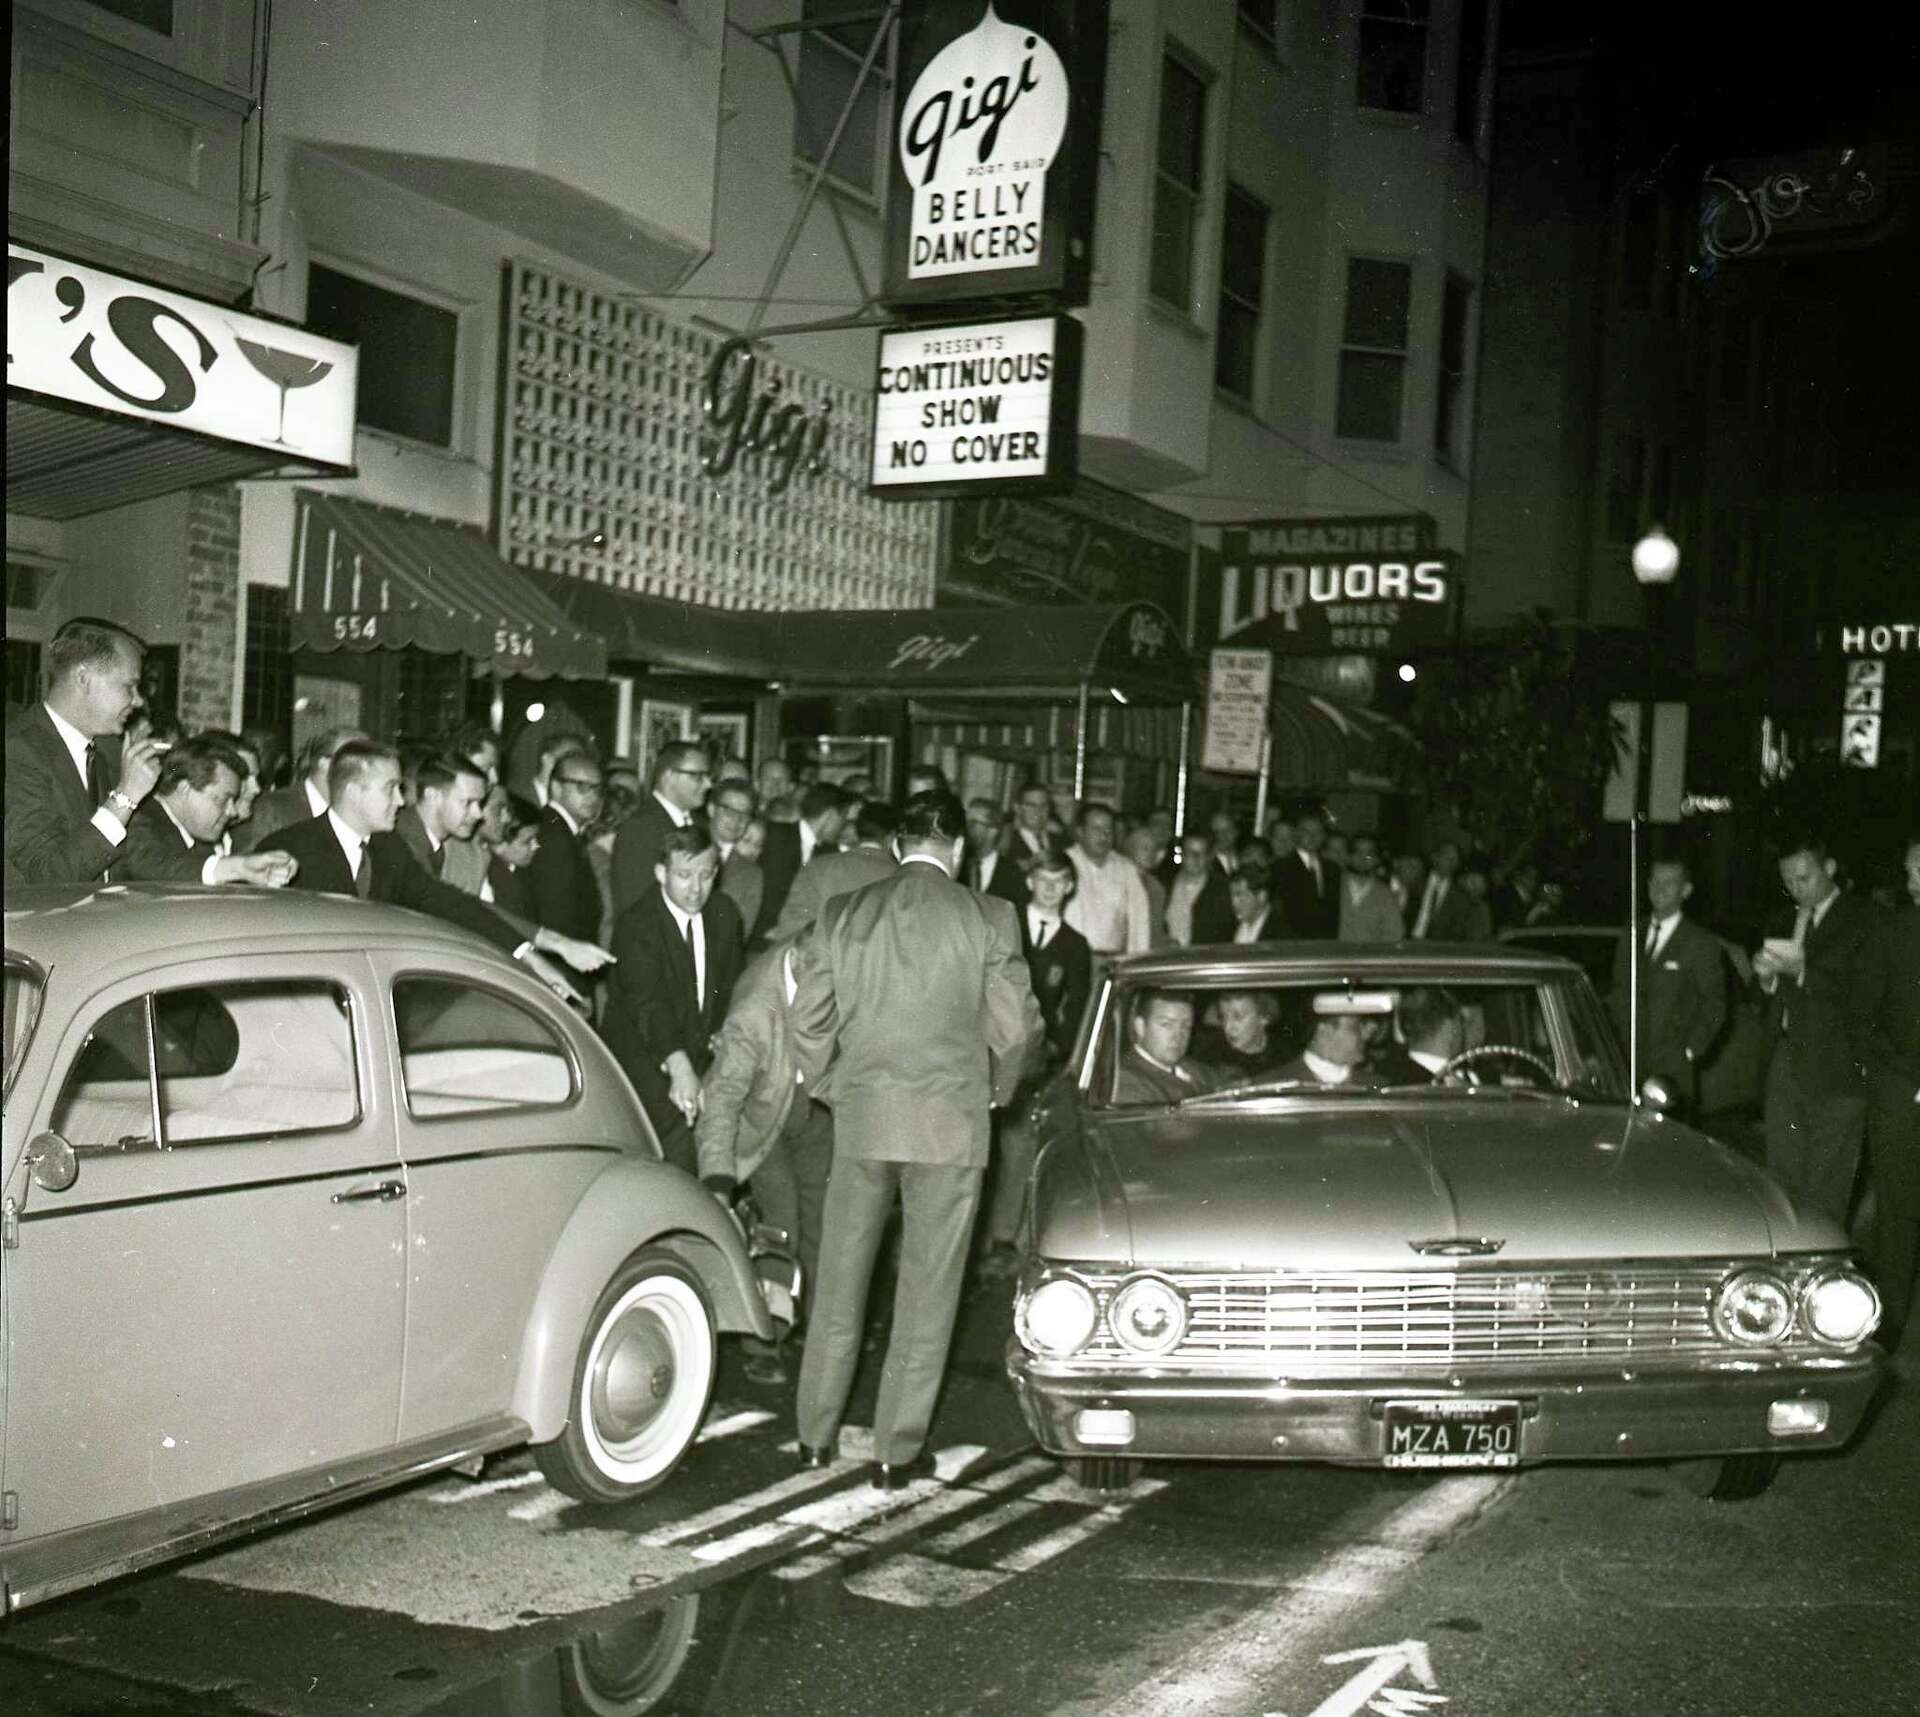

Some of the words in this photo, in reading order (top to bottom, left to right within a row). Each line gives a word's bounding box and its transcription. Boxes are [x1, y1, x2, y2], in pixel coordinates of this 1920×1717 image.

[966, 163, 1004, 176] PORT
[929, 181, 1031, 224] BELLY
[914, 222, 1038, 266] DANCERS
[7, 255, 218, 413] 'S
[923, 335, 1004, 354] PRESENTS
[879, 352, 1050, 394] CONTINUOUS
[921, 395, 1002, 428] SHOW
[891, 440, 927, 468] NO
[952, 431, 1039, 464] COVER
[1249, 525, 1417, 552] MAGAZINES
[1219, 561, 1446, 640] LIQUORS
[334, 615, 377, 640] 554
[494, 629, 534, 656] 554
[1843, 623, 1920, 653] HOT
[1392, 1425, 1450, 1452] MZA
[1461, 1425, 1512, 1452] 750
